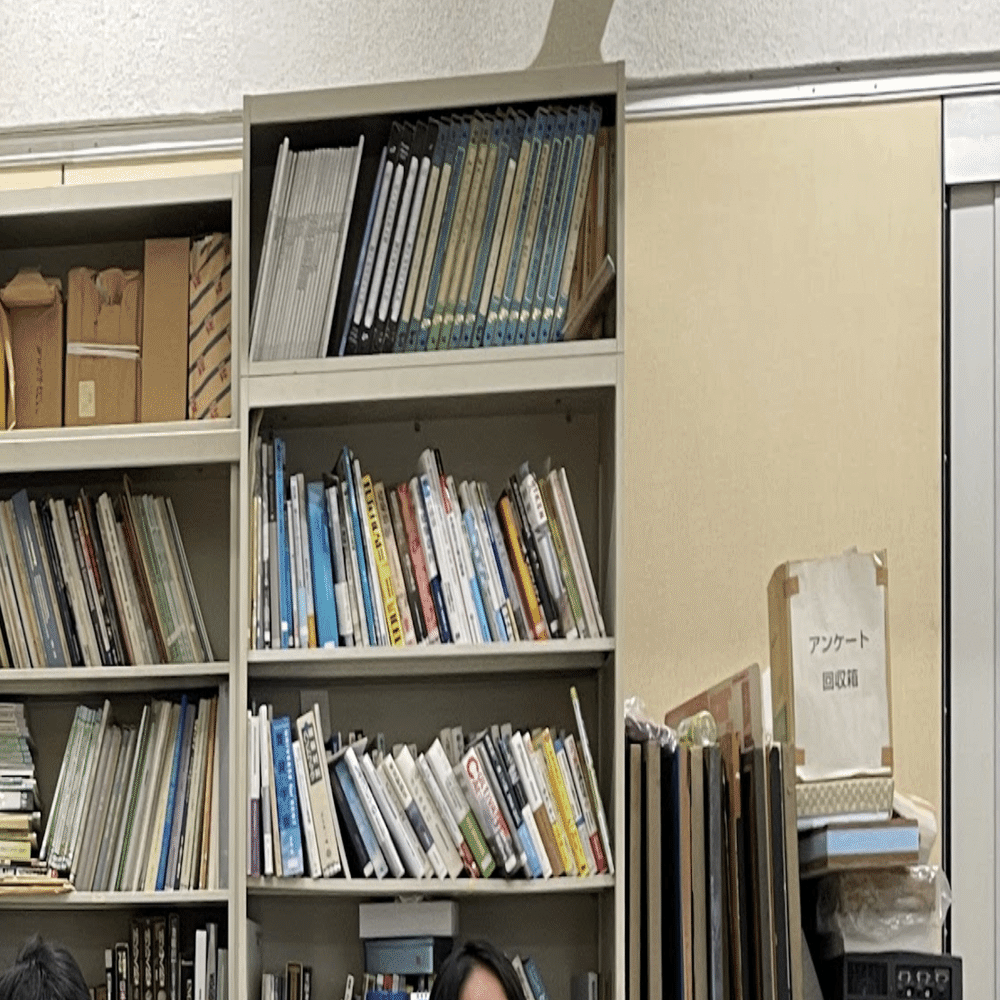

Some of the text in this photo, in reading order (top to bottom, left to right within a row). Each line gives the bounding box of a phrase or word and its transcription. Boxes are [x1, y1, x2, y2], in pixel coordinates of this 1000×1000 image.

[809, 630, 869, 654] アンケート
[822, 669, 859, 691] 回収箱
